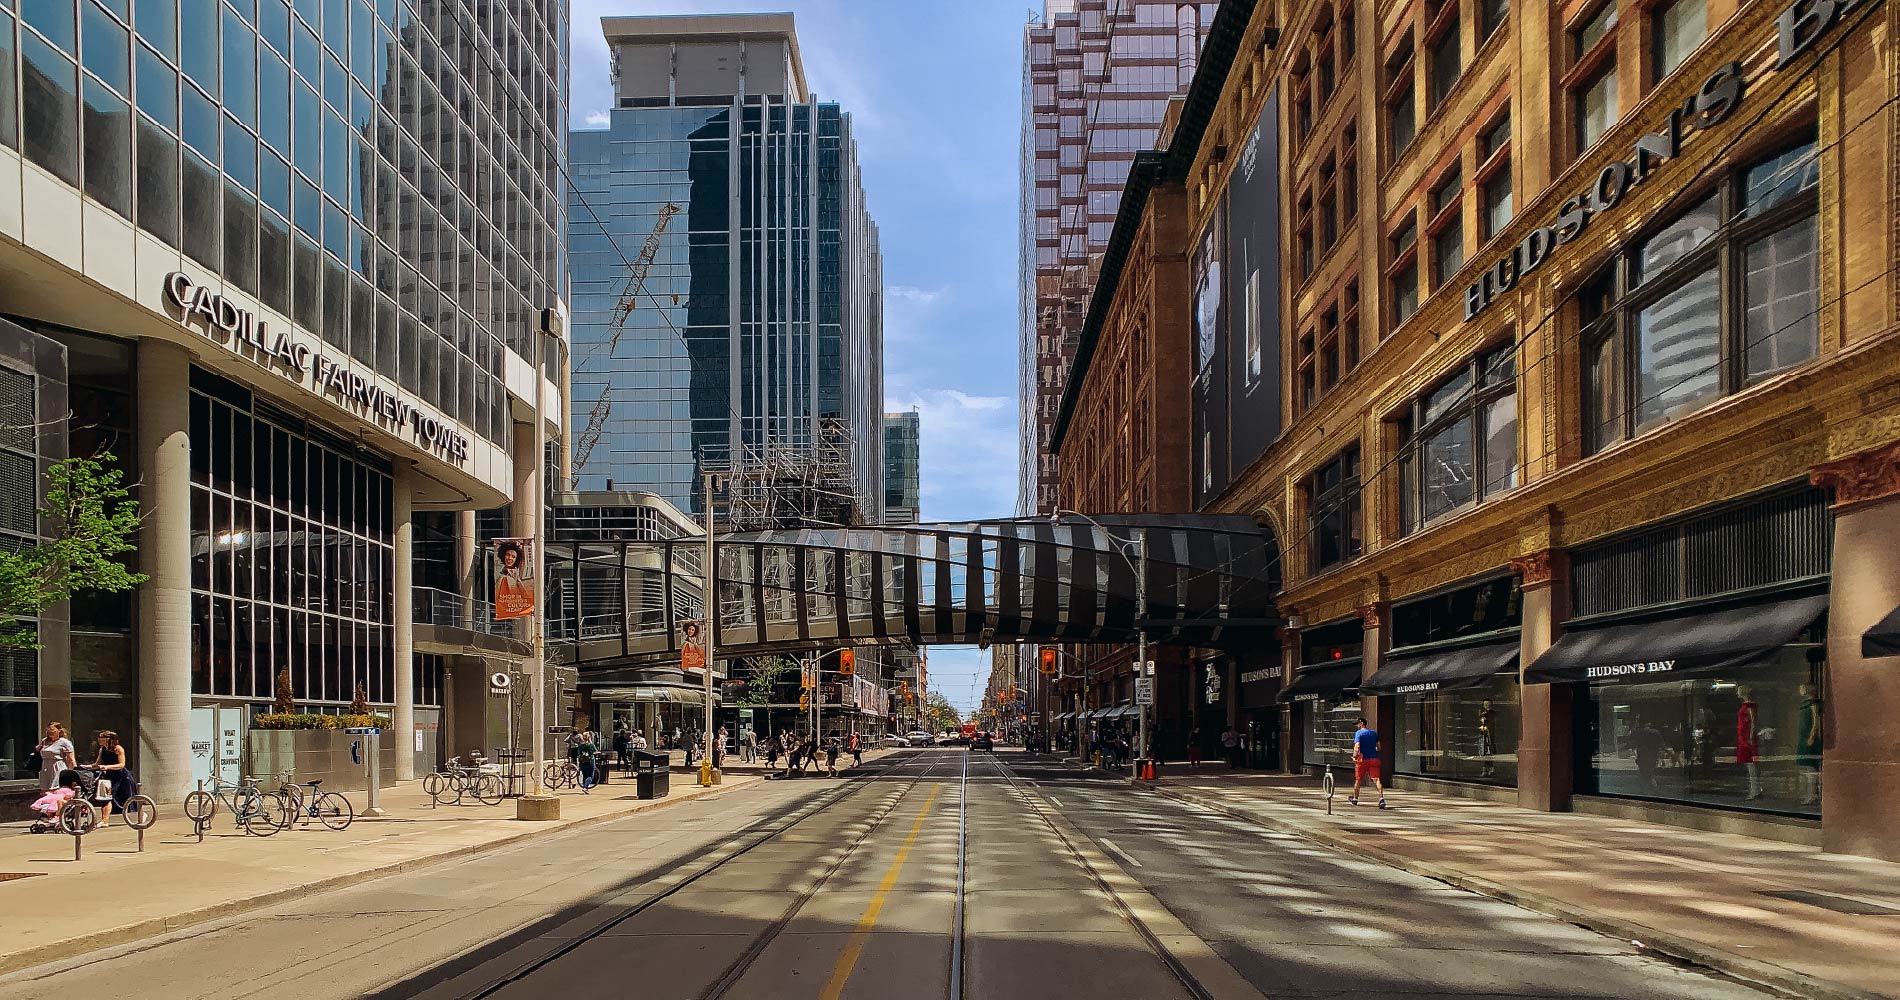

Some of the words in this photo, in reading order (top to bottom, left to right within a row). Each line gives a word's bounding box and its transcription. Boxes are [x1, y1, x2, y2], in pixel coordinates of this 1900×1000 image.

[1464, 61, 1739, 321] HUDSON'S
[163, 271, 311, 373] CADILLAC
[313, 353, 411, 427] FAIRVIEW
[412, 408, 469, 461] TOWER
[1425, 682, 1439, 690] BAY
[1586, 663, 1646, 678] HUDSON'S
[1647, 660, 1676, 673] BAY
